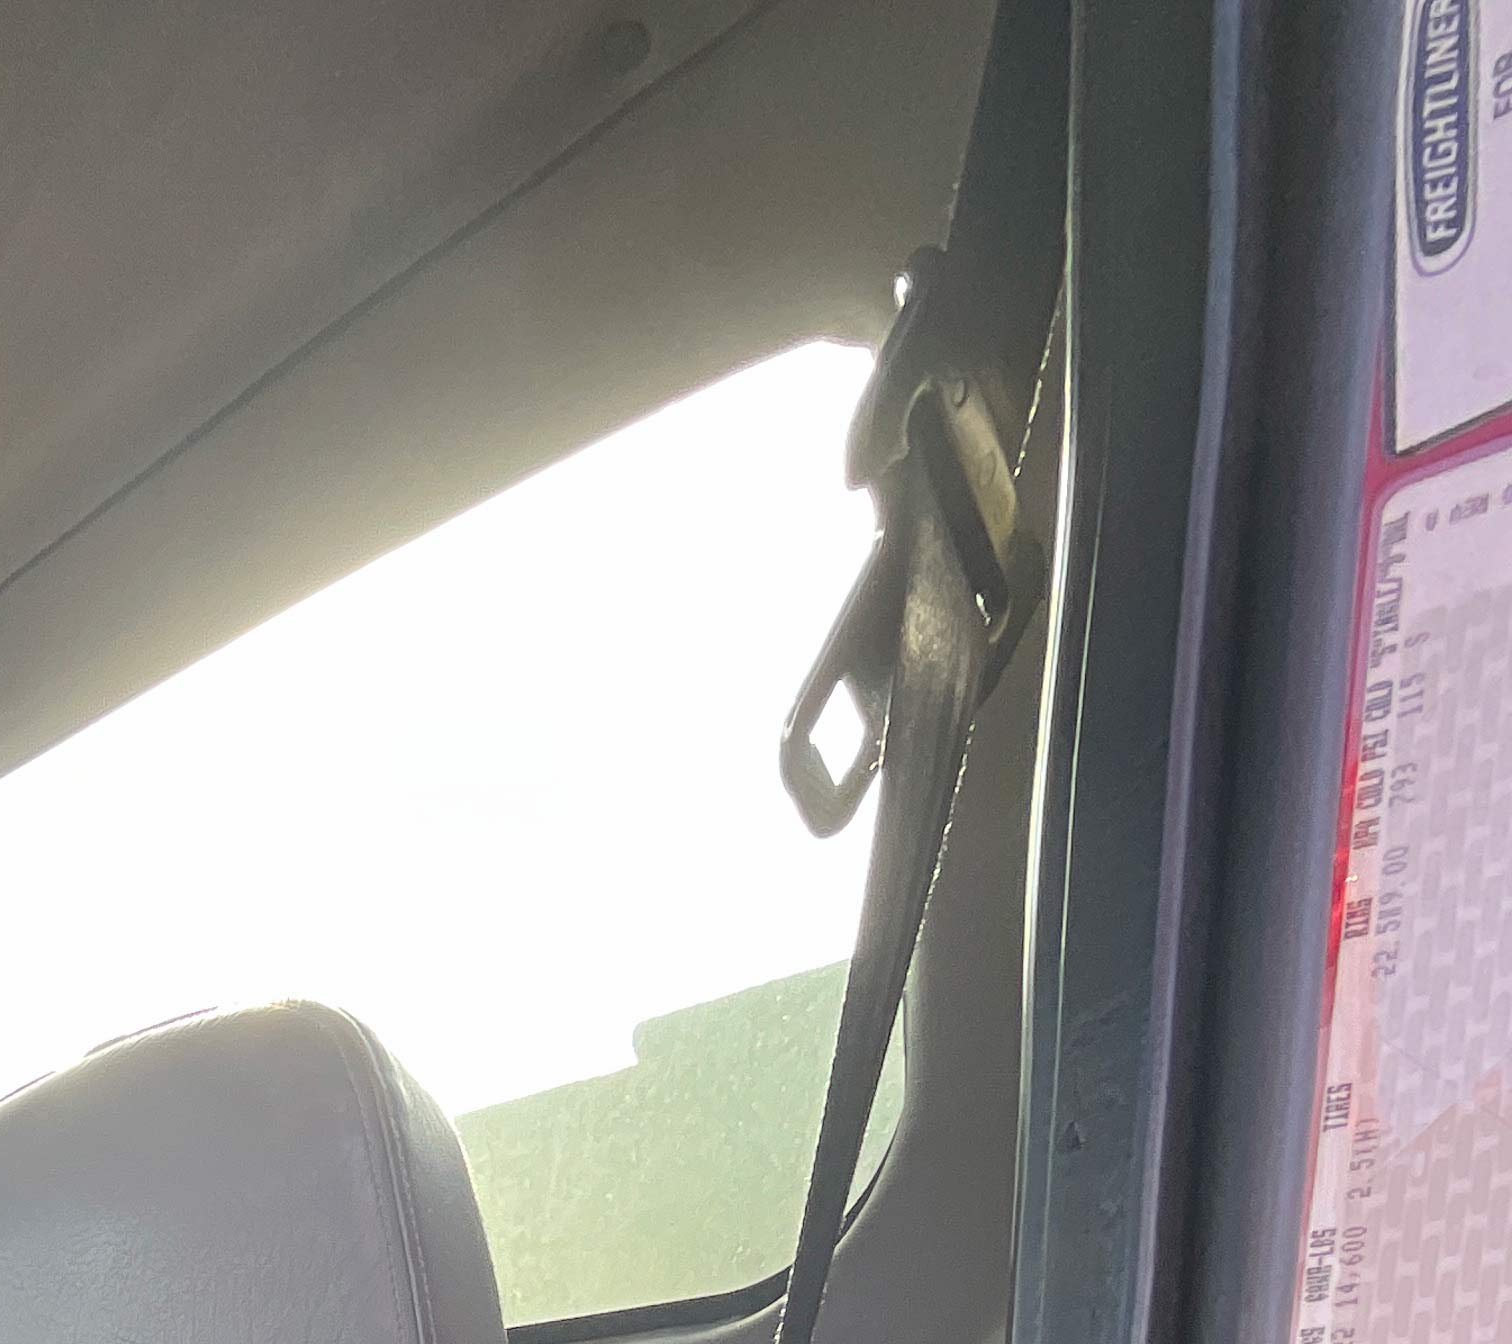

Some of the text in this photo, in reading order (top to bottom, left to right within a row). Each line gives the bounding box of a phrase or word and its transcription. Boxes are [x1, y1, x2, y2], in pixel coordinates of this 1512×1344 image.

[1422, 0, 1460, 242] FREIGHTLINER
[1322, 1082, 1353, 1134] TIRES
[1334, 1225, 1368, 1308] 14,600
